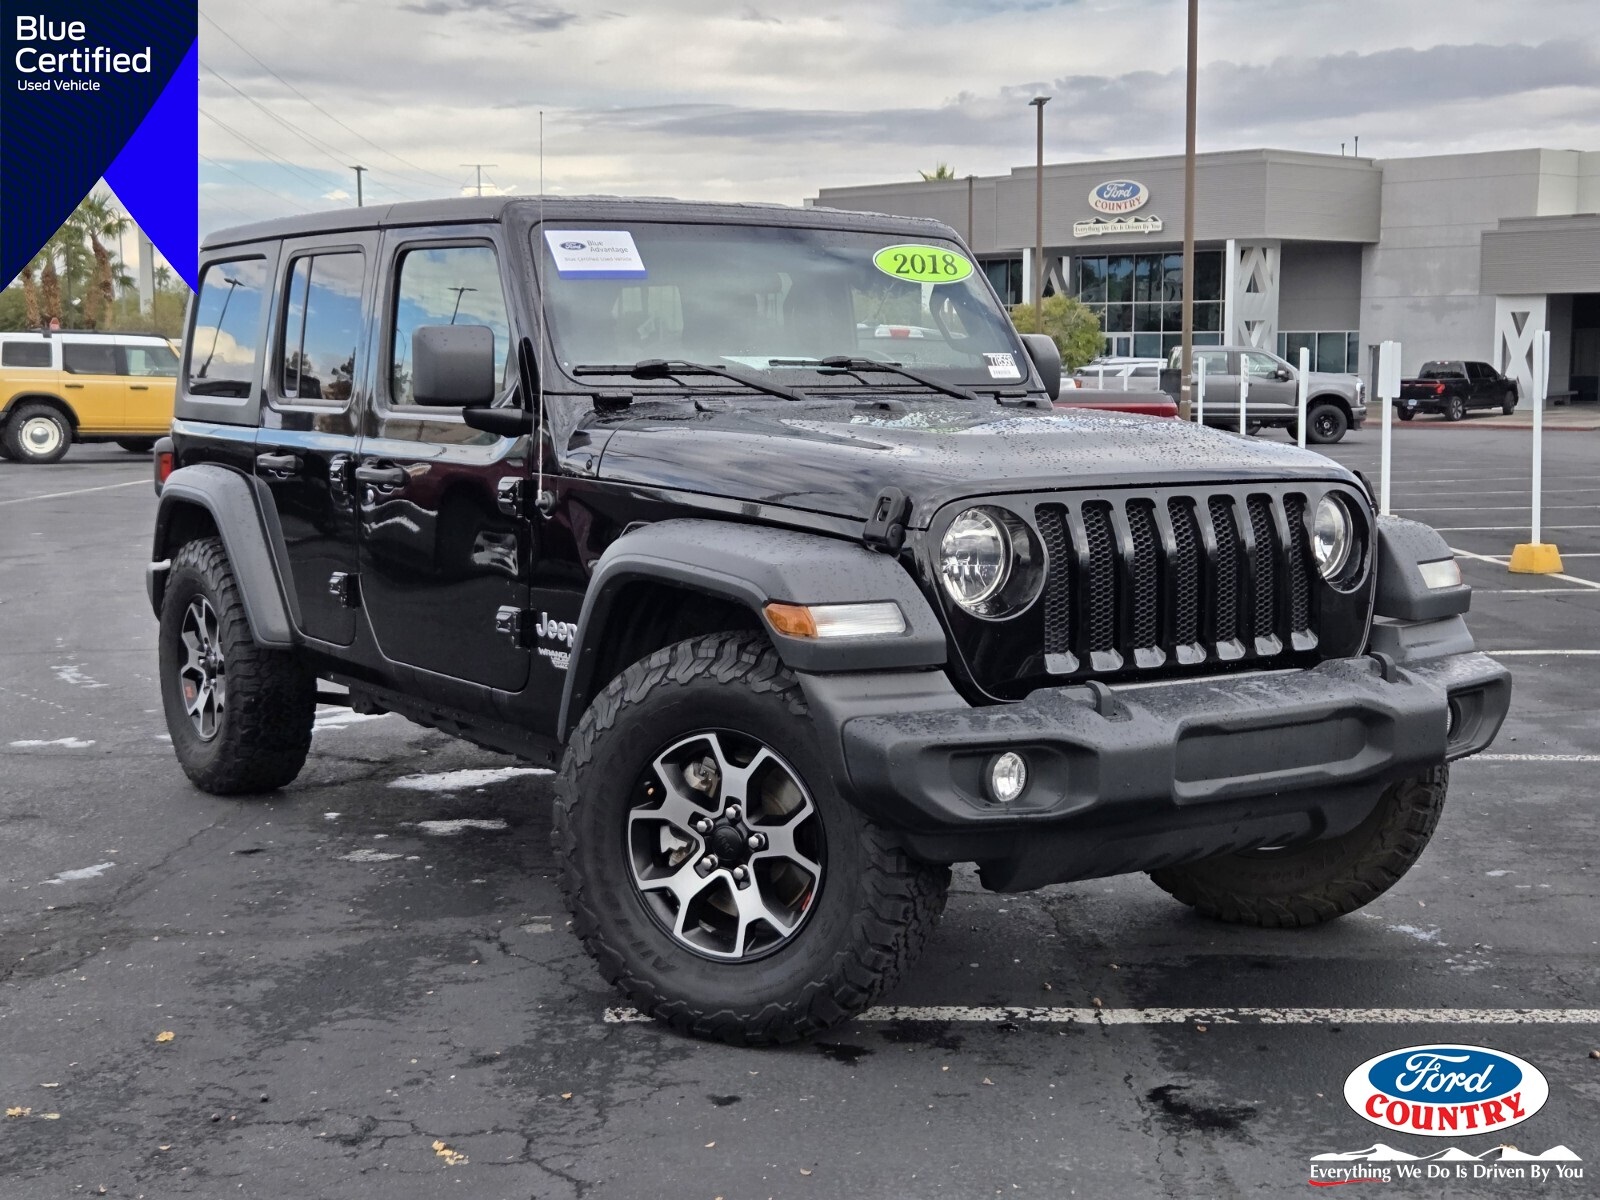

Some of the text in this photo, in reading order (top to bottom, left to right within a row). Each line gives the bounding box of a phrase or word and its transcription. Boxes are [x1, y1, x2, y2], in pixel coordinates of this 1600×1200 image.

[1103, 183, 1133, 199] Ford
[1094, 196, 1141, 211] COUNTRY
[1075, 224, 1100, 233] Everything
[893, 253, 958, 276] 2018
[535, 611, 577, 648] Jeep
